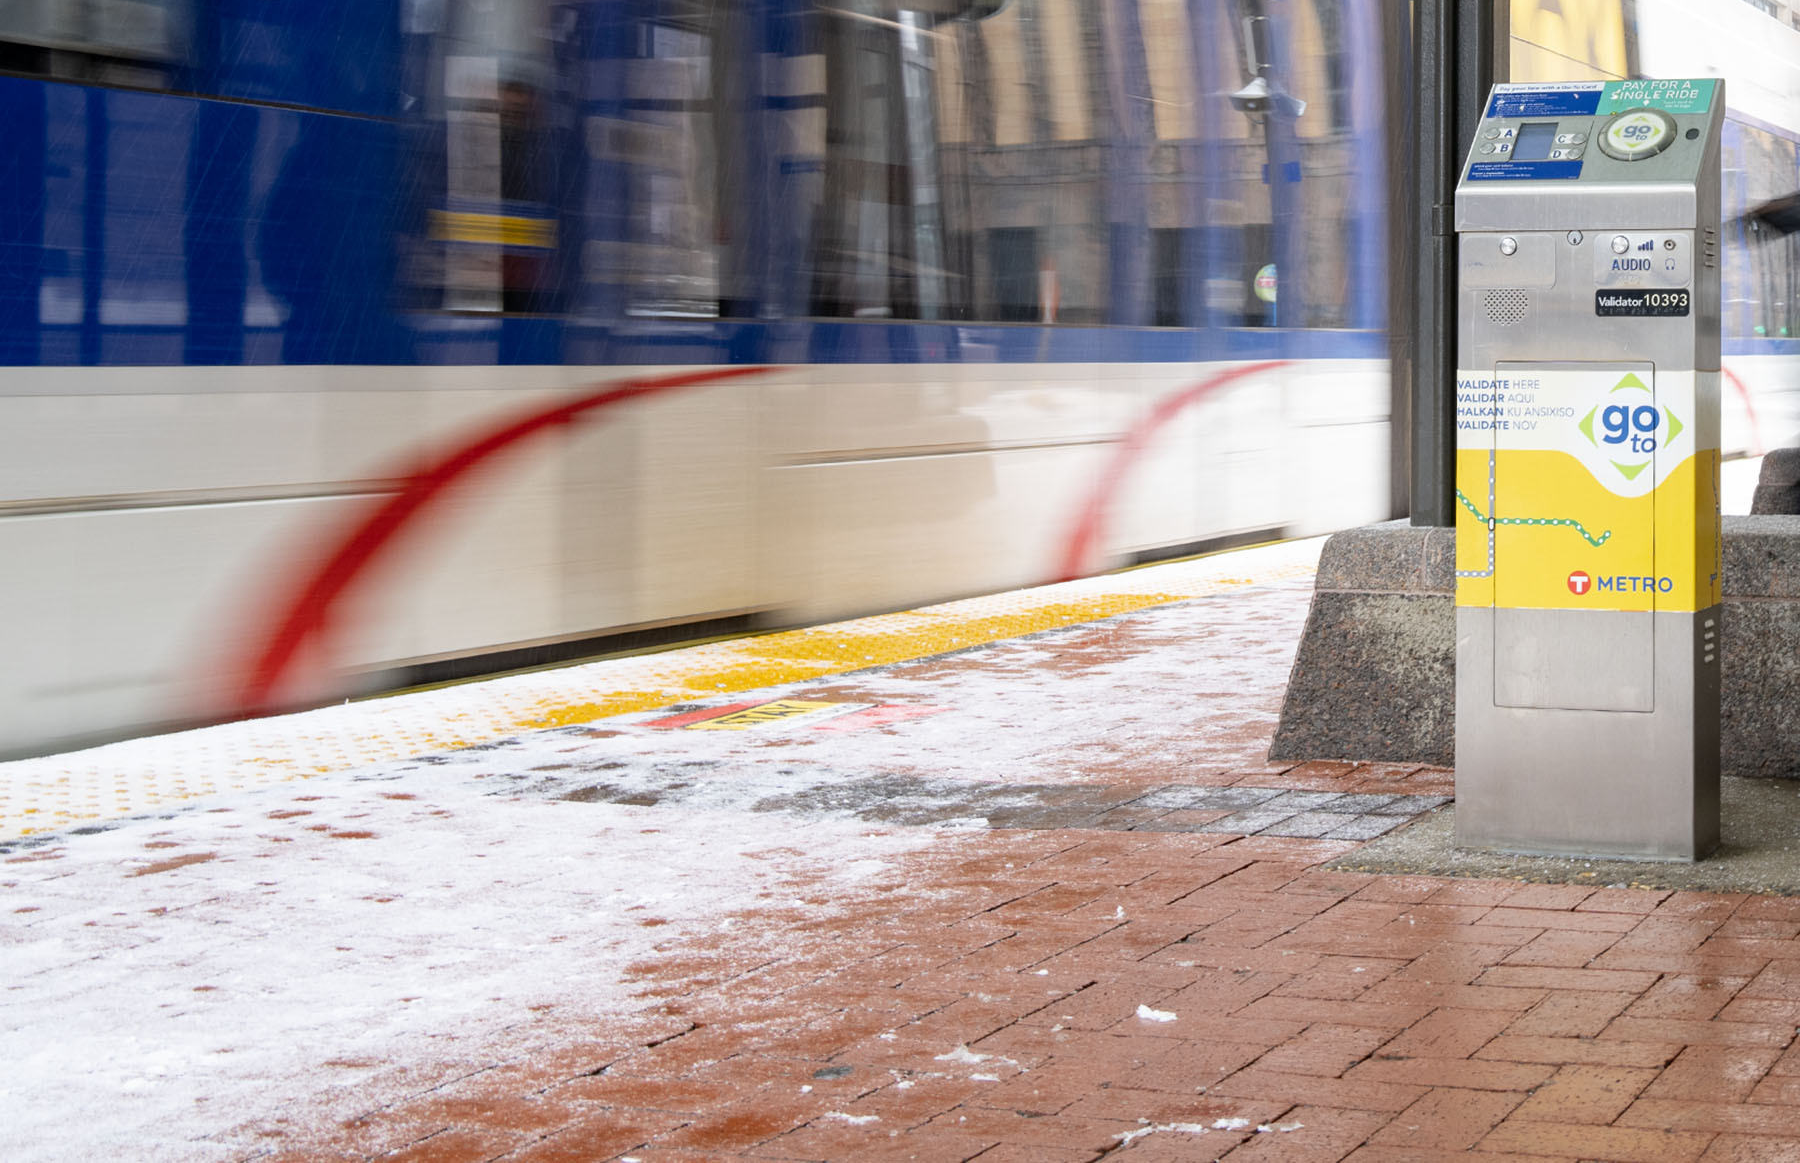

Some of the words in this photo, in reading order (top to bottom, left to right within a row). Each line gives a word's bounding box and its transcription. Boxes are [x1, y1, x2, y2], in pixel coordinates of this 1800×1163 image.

[1622, 81, 1647, 90] PAY
[1651, 80, 1679, 90] FOR
[1682, 80, 1692, 89] A
[1611, 90, 1661, 100] SINGLE
[1665, 89, 1699, 99] RIDE
[1504, 129, 1513, 137] A
[1623, 125, 1652, 138] go
[1557, 134, 1566, 143] C
[1500, 144, 1509, 152] B
[1553, 150, 1561, 159] D
[1612, 258, 1651, 271] AUDIO
[1598, 295, 1643, 307] Validator
[1643, 293, 1688, 306] 10393
[1458, 380, 1509, 389] VALIDATE
[1513, 380, 1540, 389] HERE
[1458, 394, 1504, 403] VALIDAR
[1508, 394, 1535, 404] AQUI
[1458, 407, 1504, 416] HALKAN
[1507, 408, 1521, 417] KU
[1524, 407, 1575, 417] ANSIXISO
[1458, 421, 1509, 430] VALIDATE
[1513, 421, 1537, 430] NOV
[1602, 405, 1660, 444] go
[1631, 434, 1657, 453] to
[1598, 577, 1673, 593] METRO
